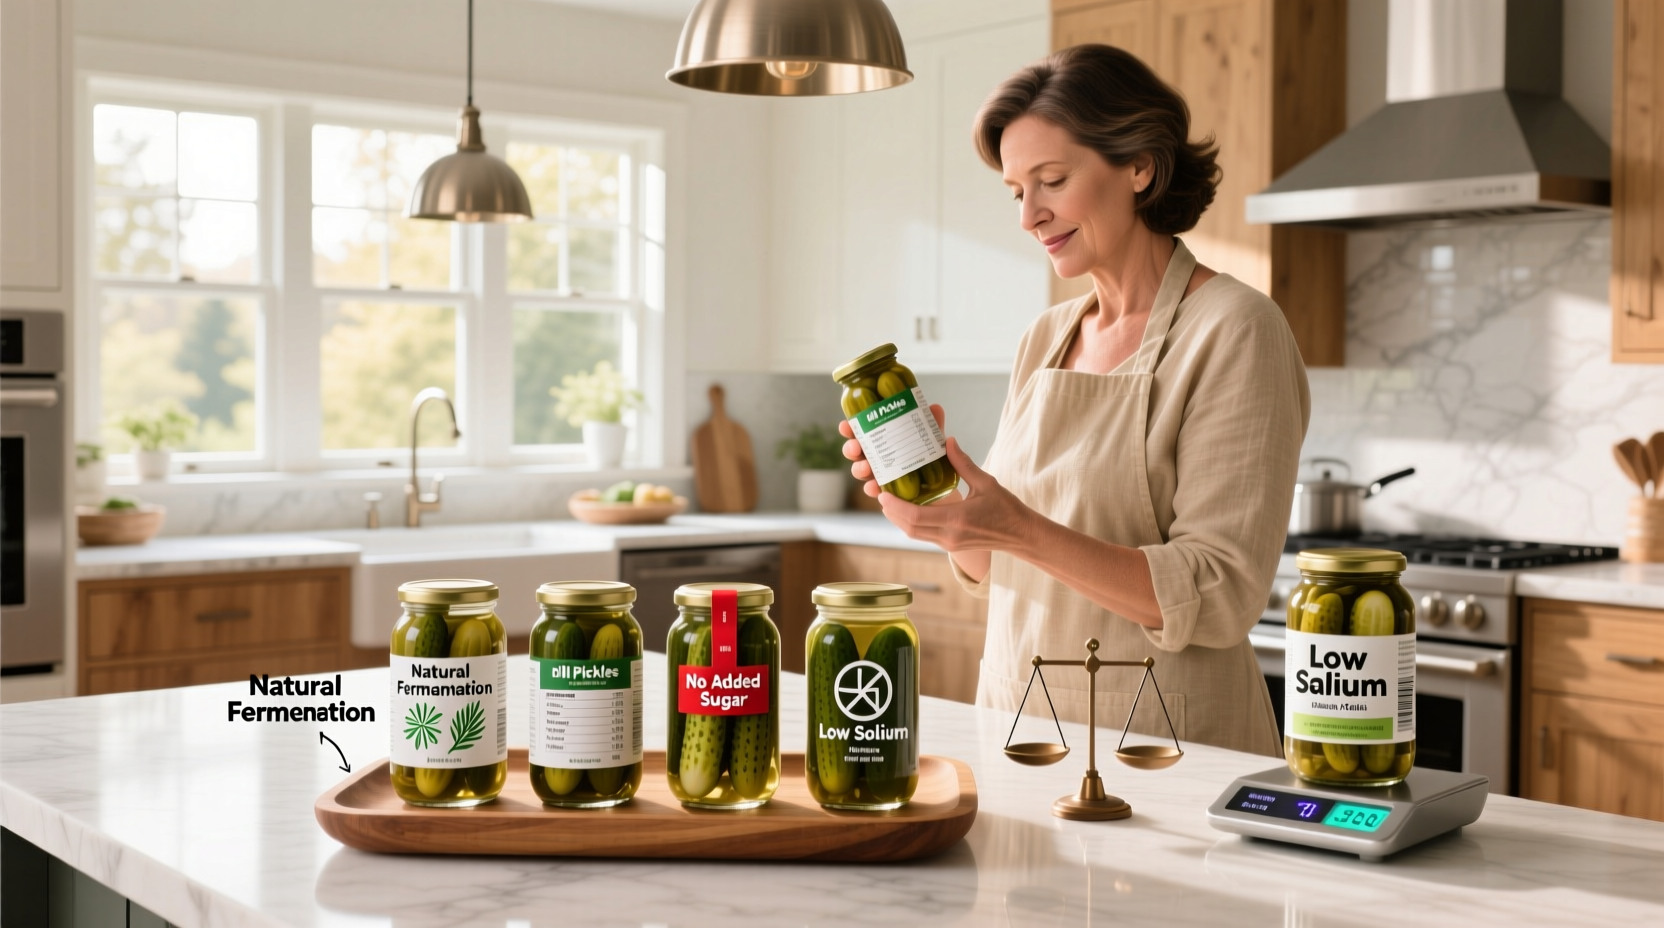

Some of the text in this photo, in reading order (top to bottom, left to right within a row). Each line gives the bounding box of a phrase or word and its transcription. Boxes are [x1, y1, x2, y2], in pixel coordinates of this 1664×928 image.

[1310, 644, 1368, 670] Low
[411, 663, 470, 679] Natural
[573, 664, 619, 680] Pickles
[686, 673, 760, 689] No Added
[1296, 669, 1387, 697] Salium
[700, 691, 748, 711] Sugar
[819, 723, 909, 741] Low Solium
